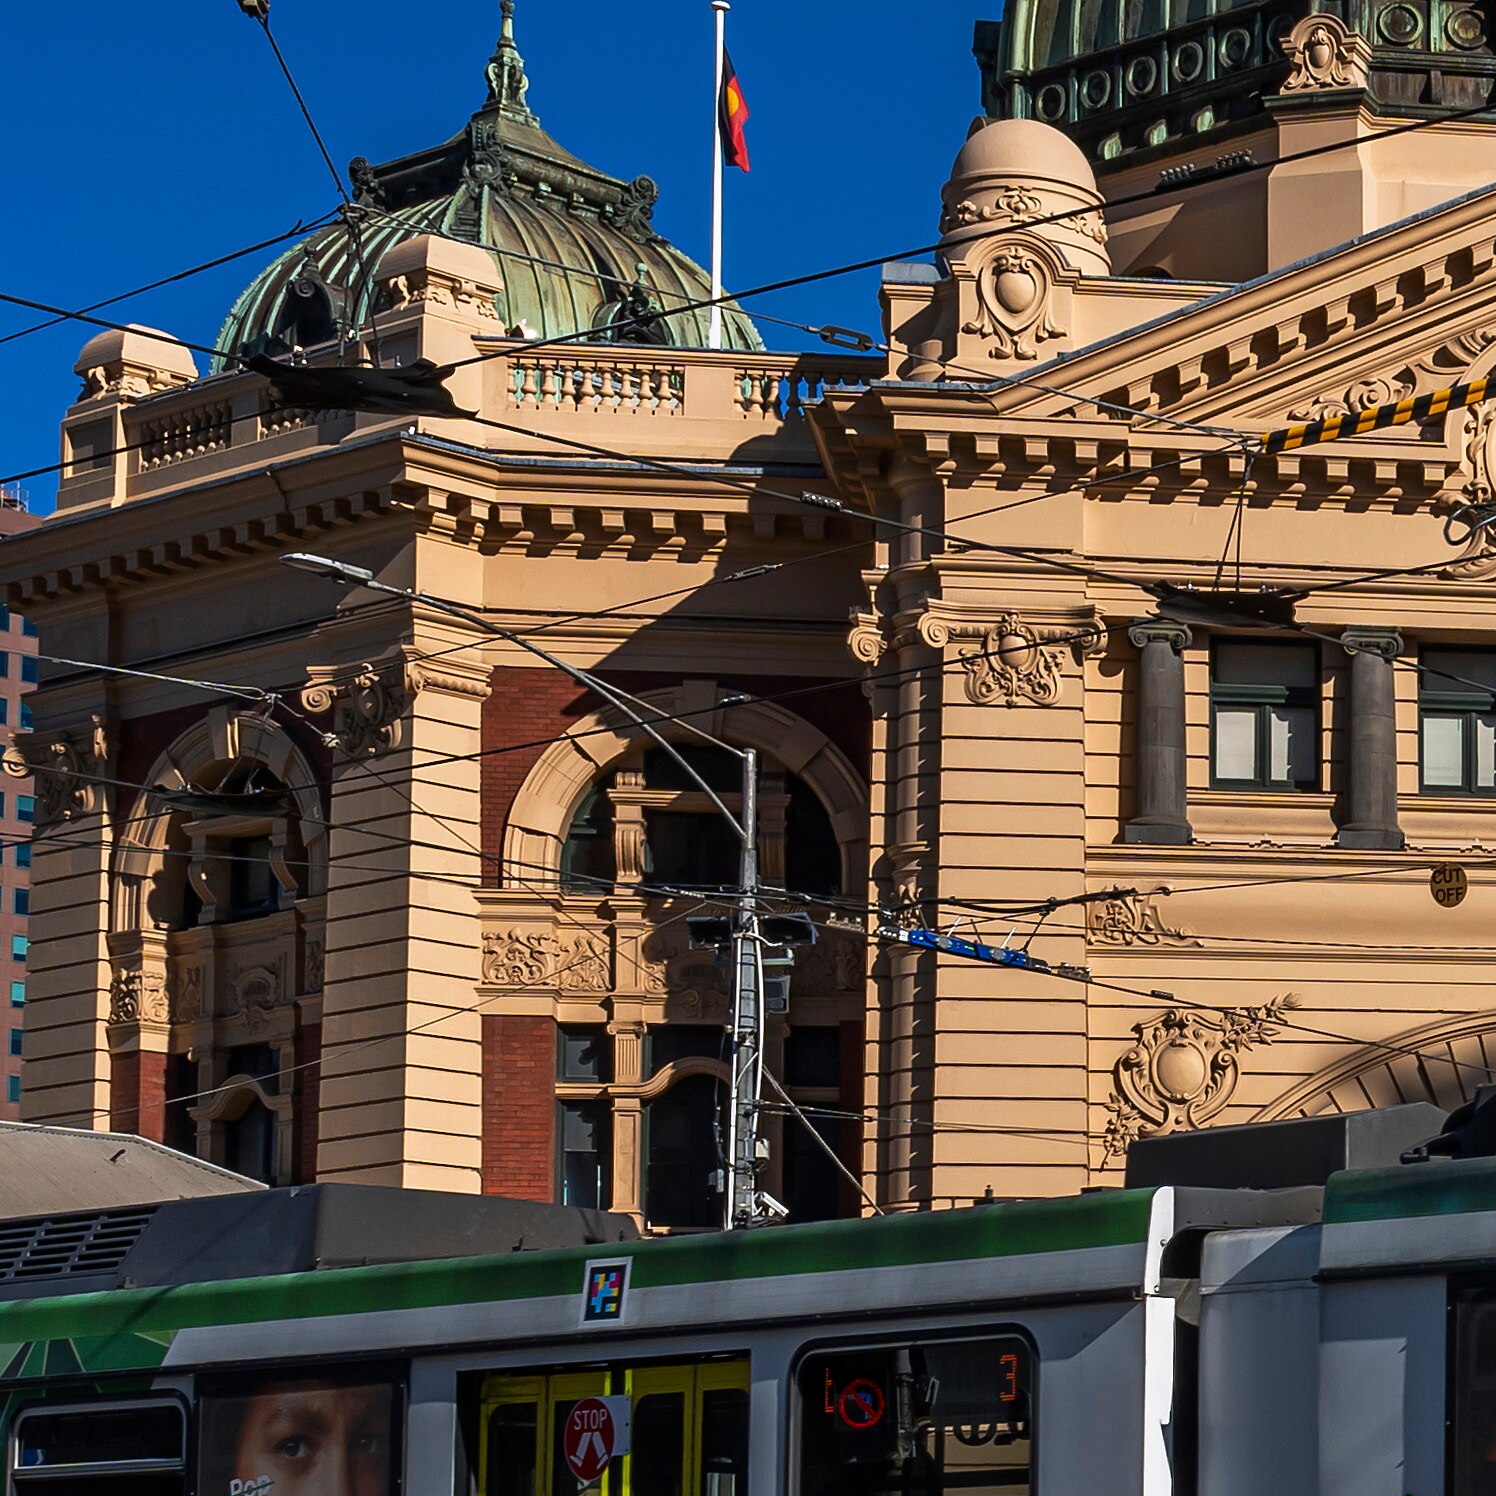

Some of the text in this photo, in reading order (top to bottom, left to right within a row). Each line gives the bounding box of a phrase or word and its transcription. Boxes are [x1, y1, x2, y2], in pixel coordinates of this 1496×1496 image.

[1432, 869, 1462, 884] CUT
[1436, 887, 1464, 902] OFF
[573, 1409, 608, 1430] STOP
